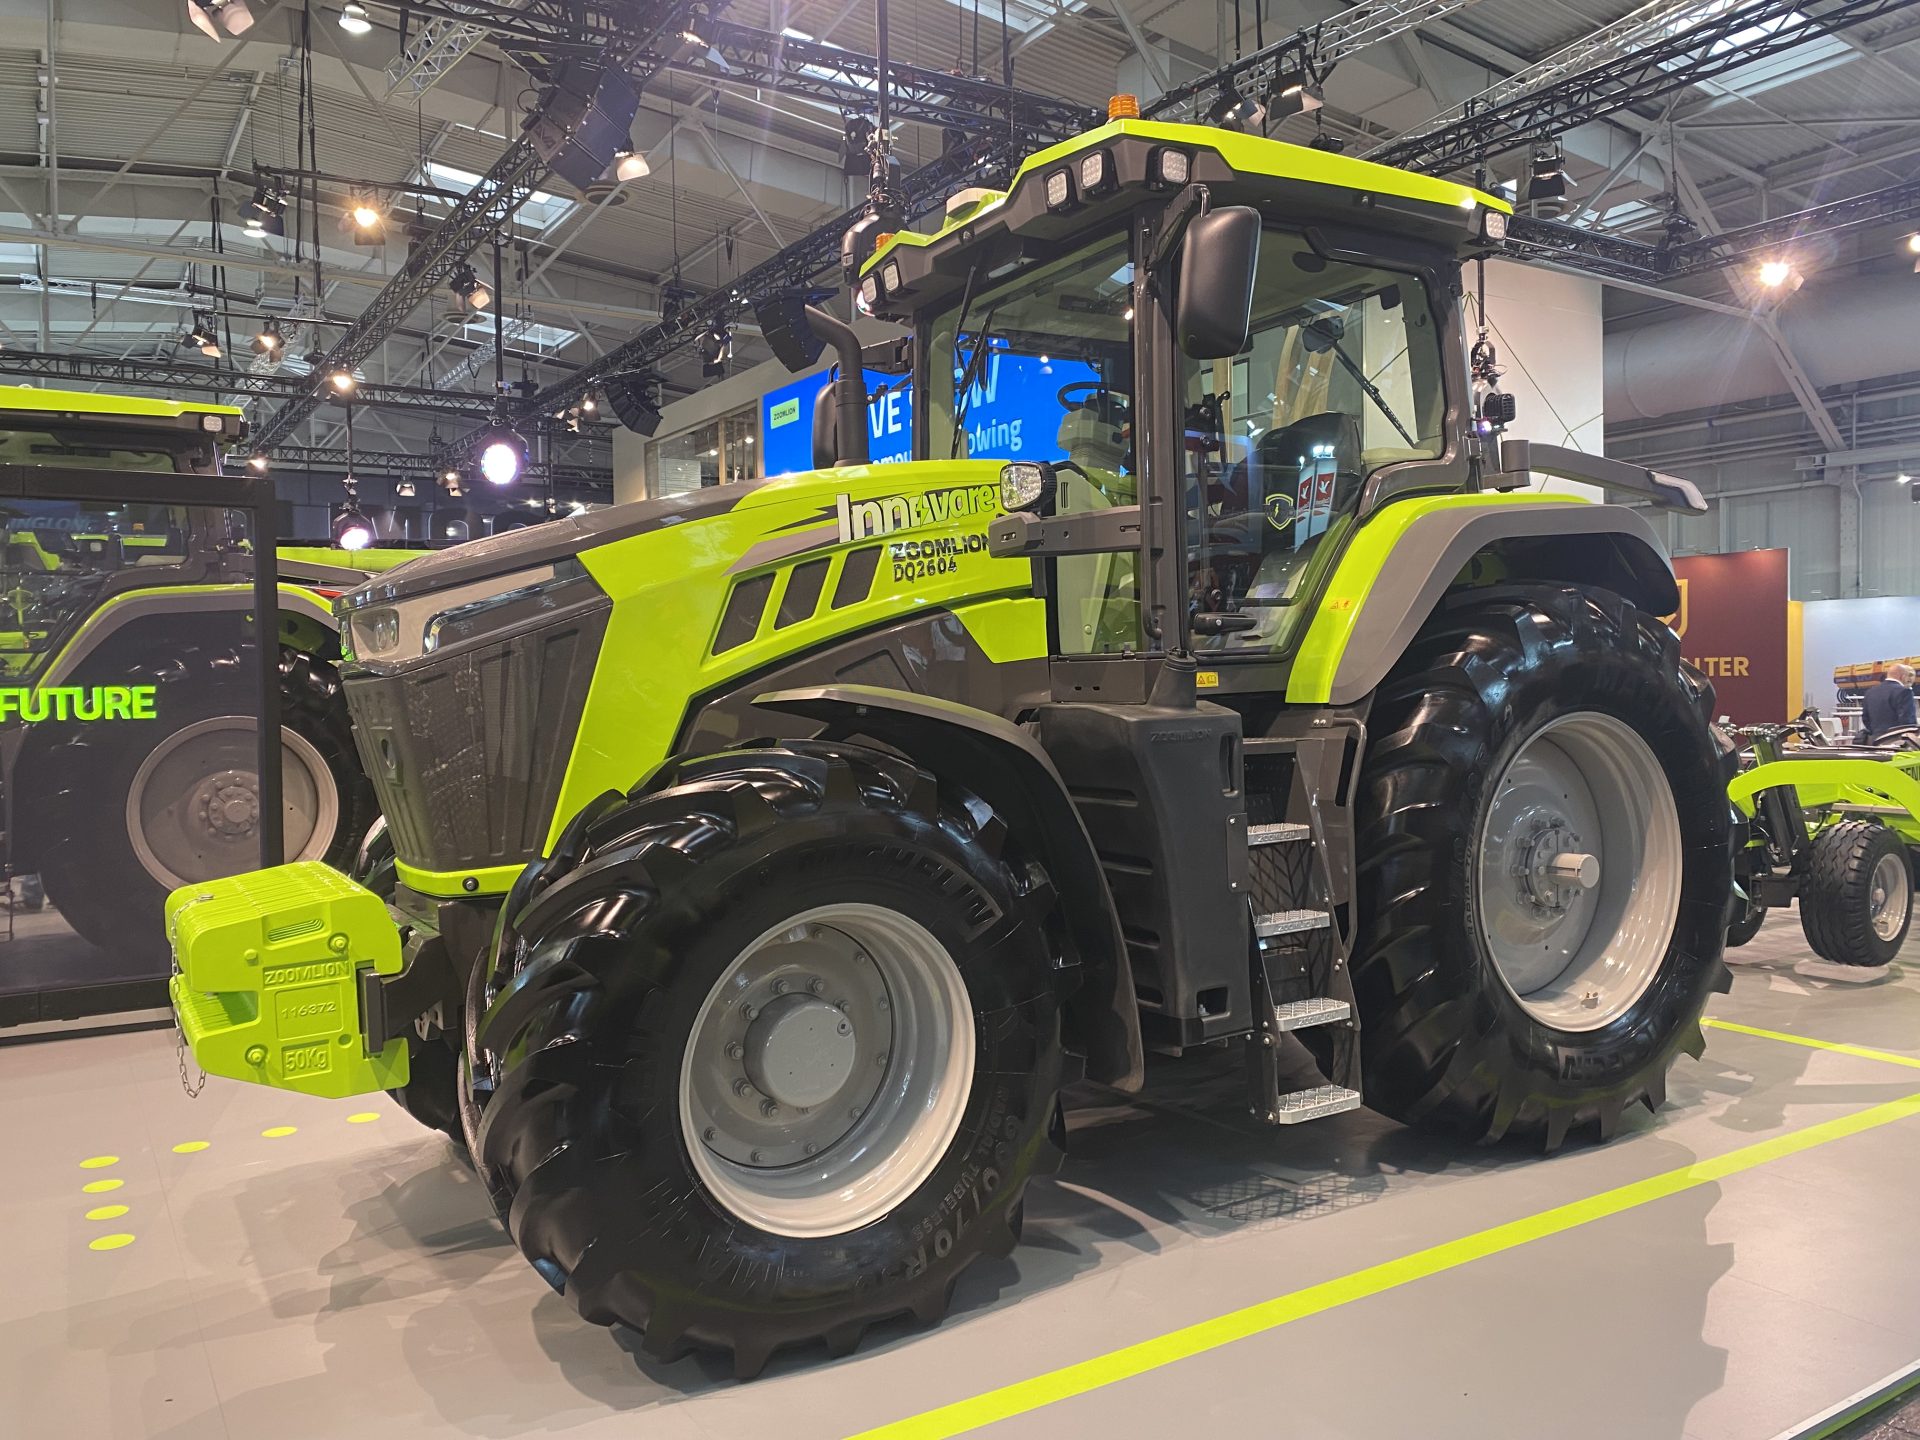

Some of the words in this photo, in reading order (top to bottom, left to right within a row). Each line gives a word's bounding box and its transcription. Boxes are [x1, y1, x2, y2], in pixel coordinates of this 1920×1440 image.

[773, 406, 797, 421] ZOOMLION
[836, 485, 995, 544] Innovare
[893, 556, 958, 583] DQ2604
[0, 685, 158, 723] FUTURE
[264, 961, 349, 986] ZOOMLION
[280, 1000, 337, 1019] 116372
[285, 1047, 328, 1072] 50Kg
